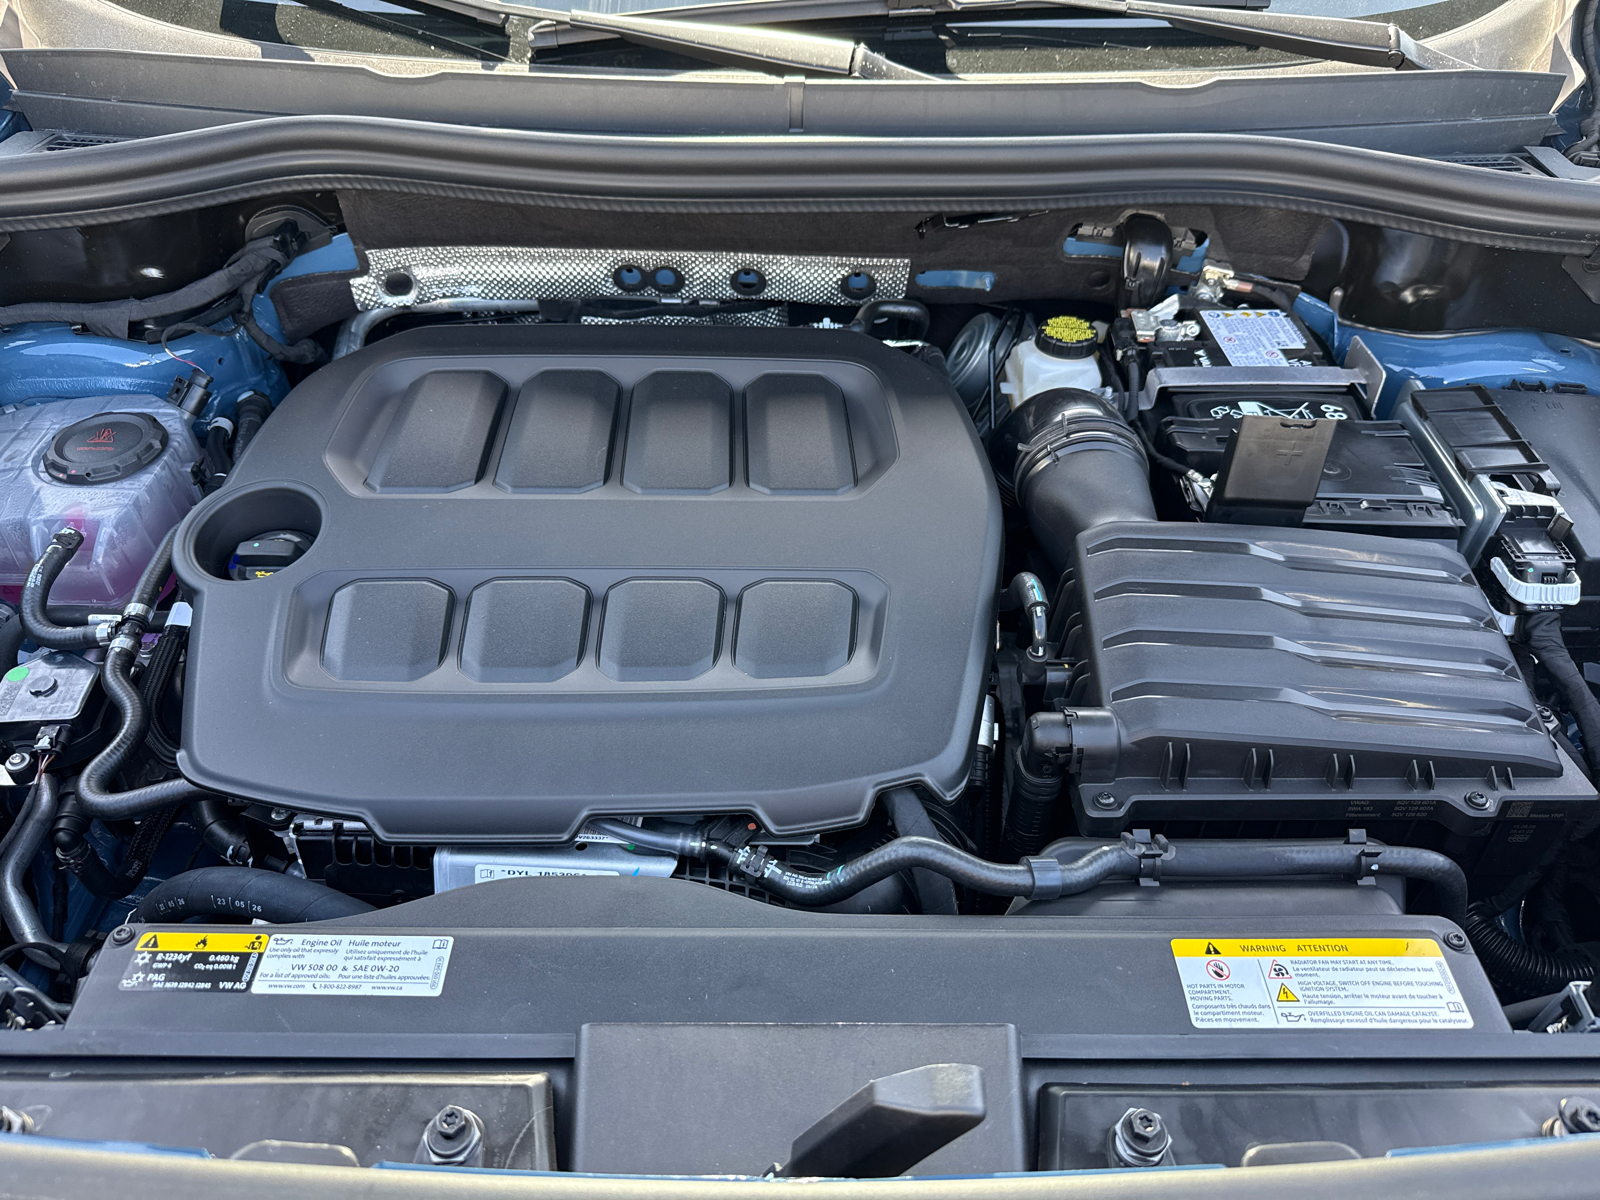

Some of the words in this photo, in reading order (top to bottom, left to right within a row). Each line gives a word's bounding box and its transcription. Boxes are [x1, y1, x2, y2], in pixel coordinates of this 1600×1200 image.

[301, 939, 328, 947] Engine
[156, 952, 192, 963] R-1234yf
[230, 955, 239, 963] kg
